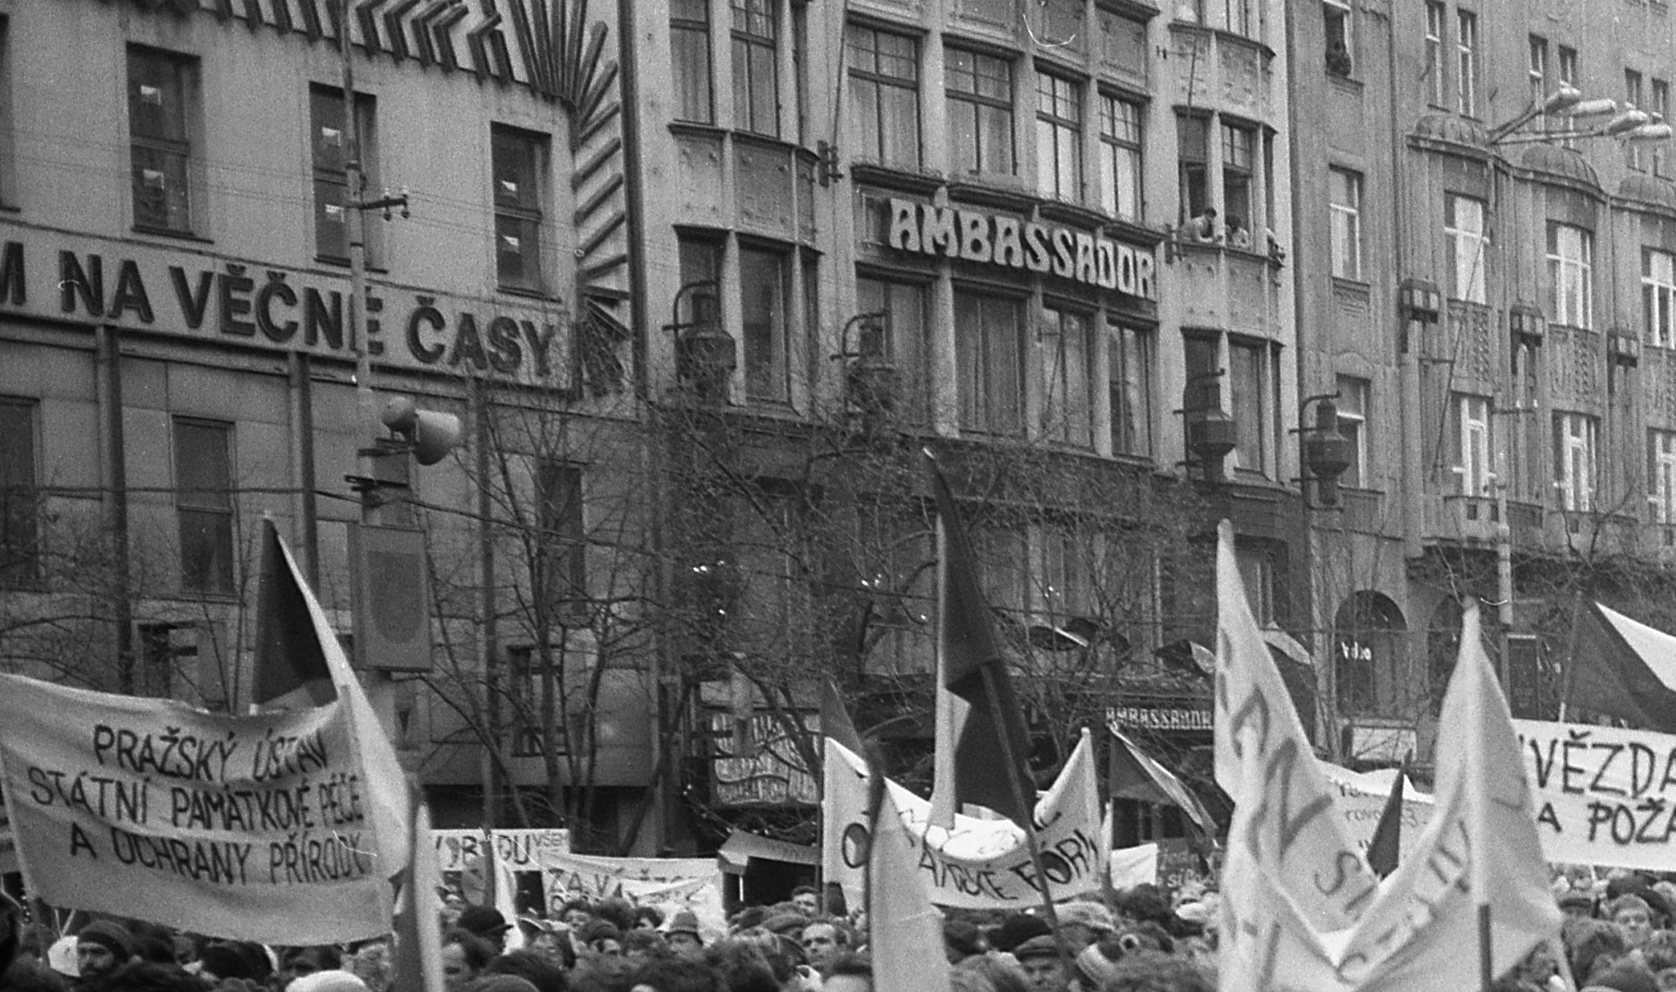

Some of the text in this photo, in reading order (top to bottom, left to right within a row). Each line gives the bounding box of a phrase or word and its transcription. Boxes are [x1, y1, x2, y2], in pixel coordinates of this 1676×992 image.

[889, 198, 1157, 299] AMBASSADOR
[58, 250, 154, 323] NA
[169, 264, 384, 356] VĚČNÉ
[405, 296, 555, 376] ČASY
[93, 724, 328, 783] PRAŽSKÝ ÚSTAV
[28, 766, 152, 825] STÁTNÍ
[171, 778, 314, 831] PAMÁTKOVÉ
[70, 822, 366, 885] A OCHRANY PŘÍRODY
